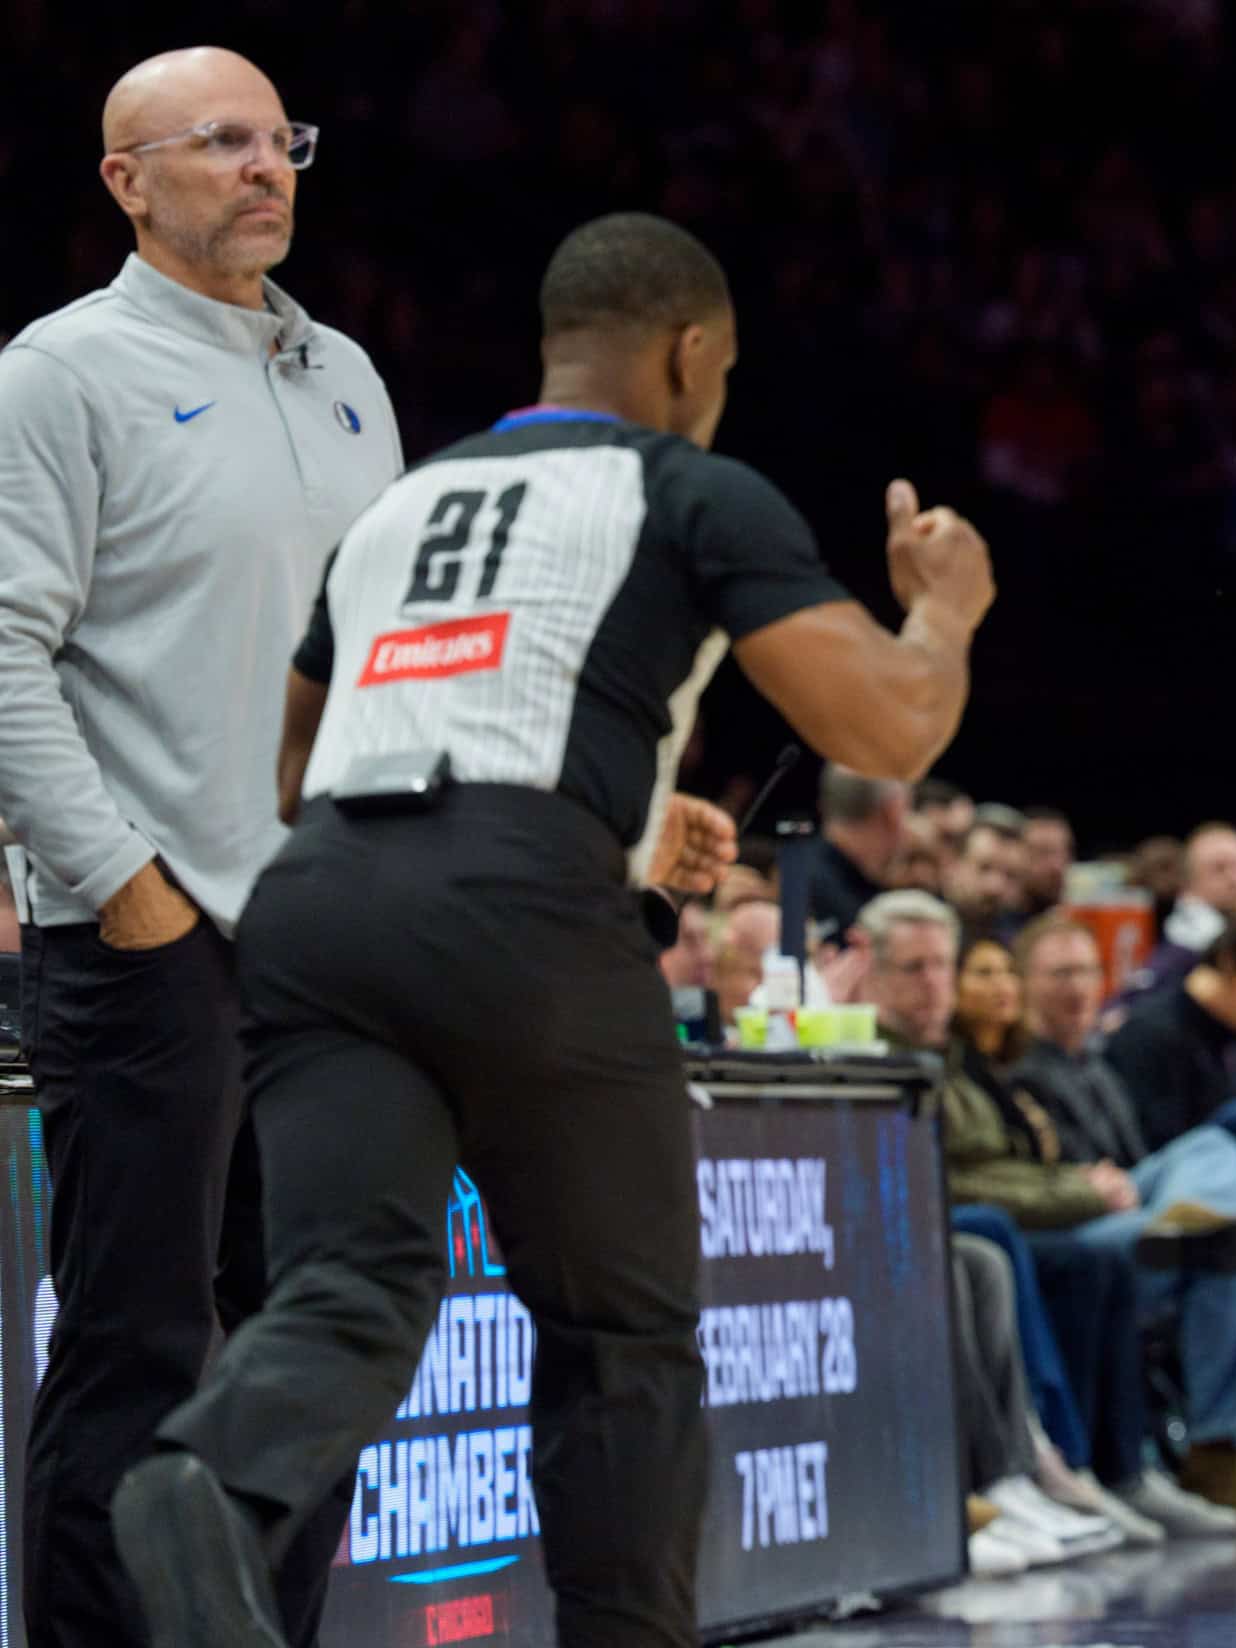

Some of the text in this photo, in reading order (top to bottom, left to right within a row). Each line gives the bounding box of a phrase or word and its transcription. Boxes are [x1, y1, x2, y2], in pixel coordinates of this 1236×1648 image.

[403, 480, 528, 603] 21
[396, 1292, 538, 1420] NATIO
[735, 1450, 754, 1551] 7
